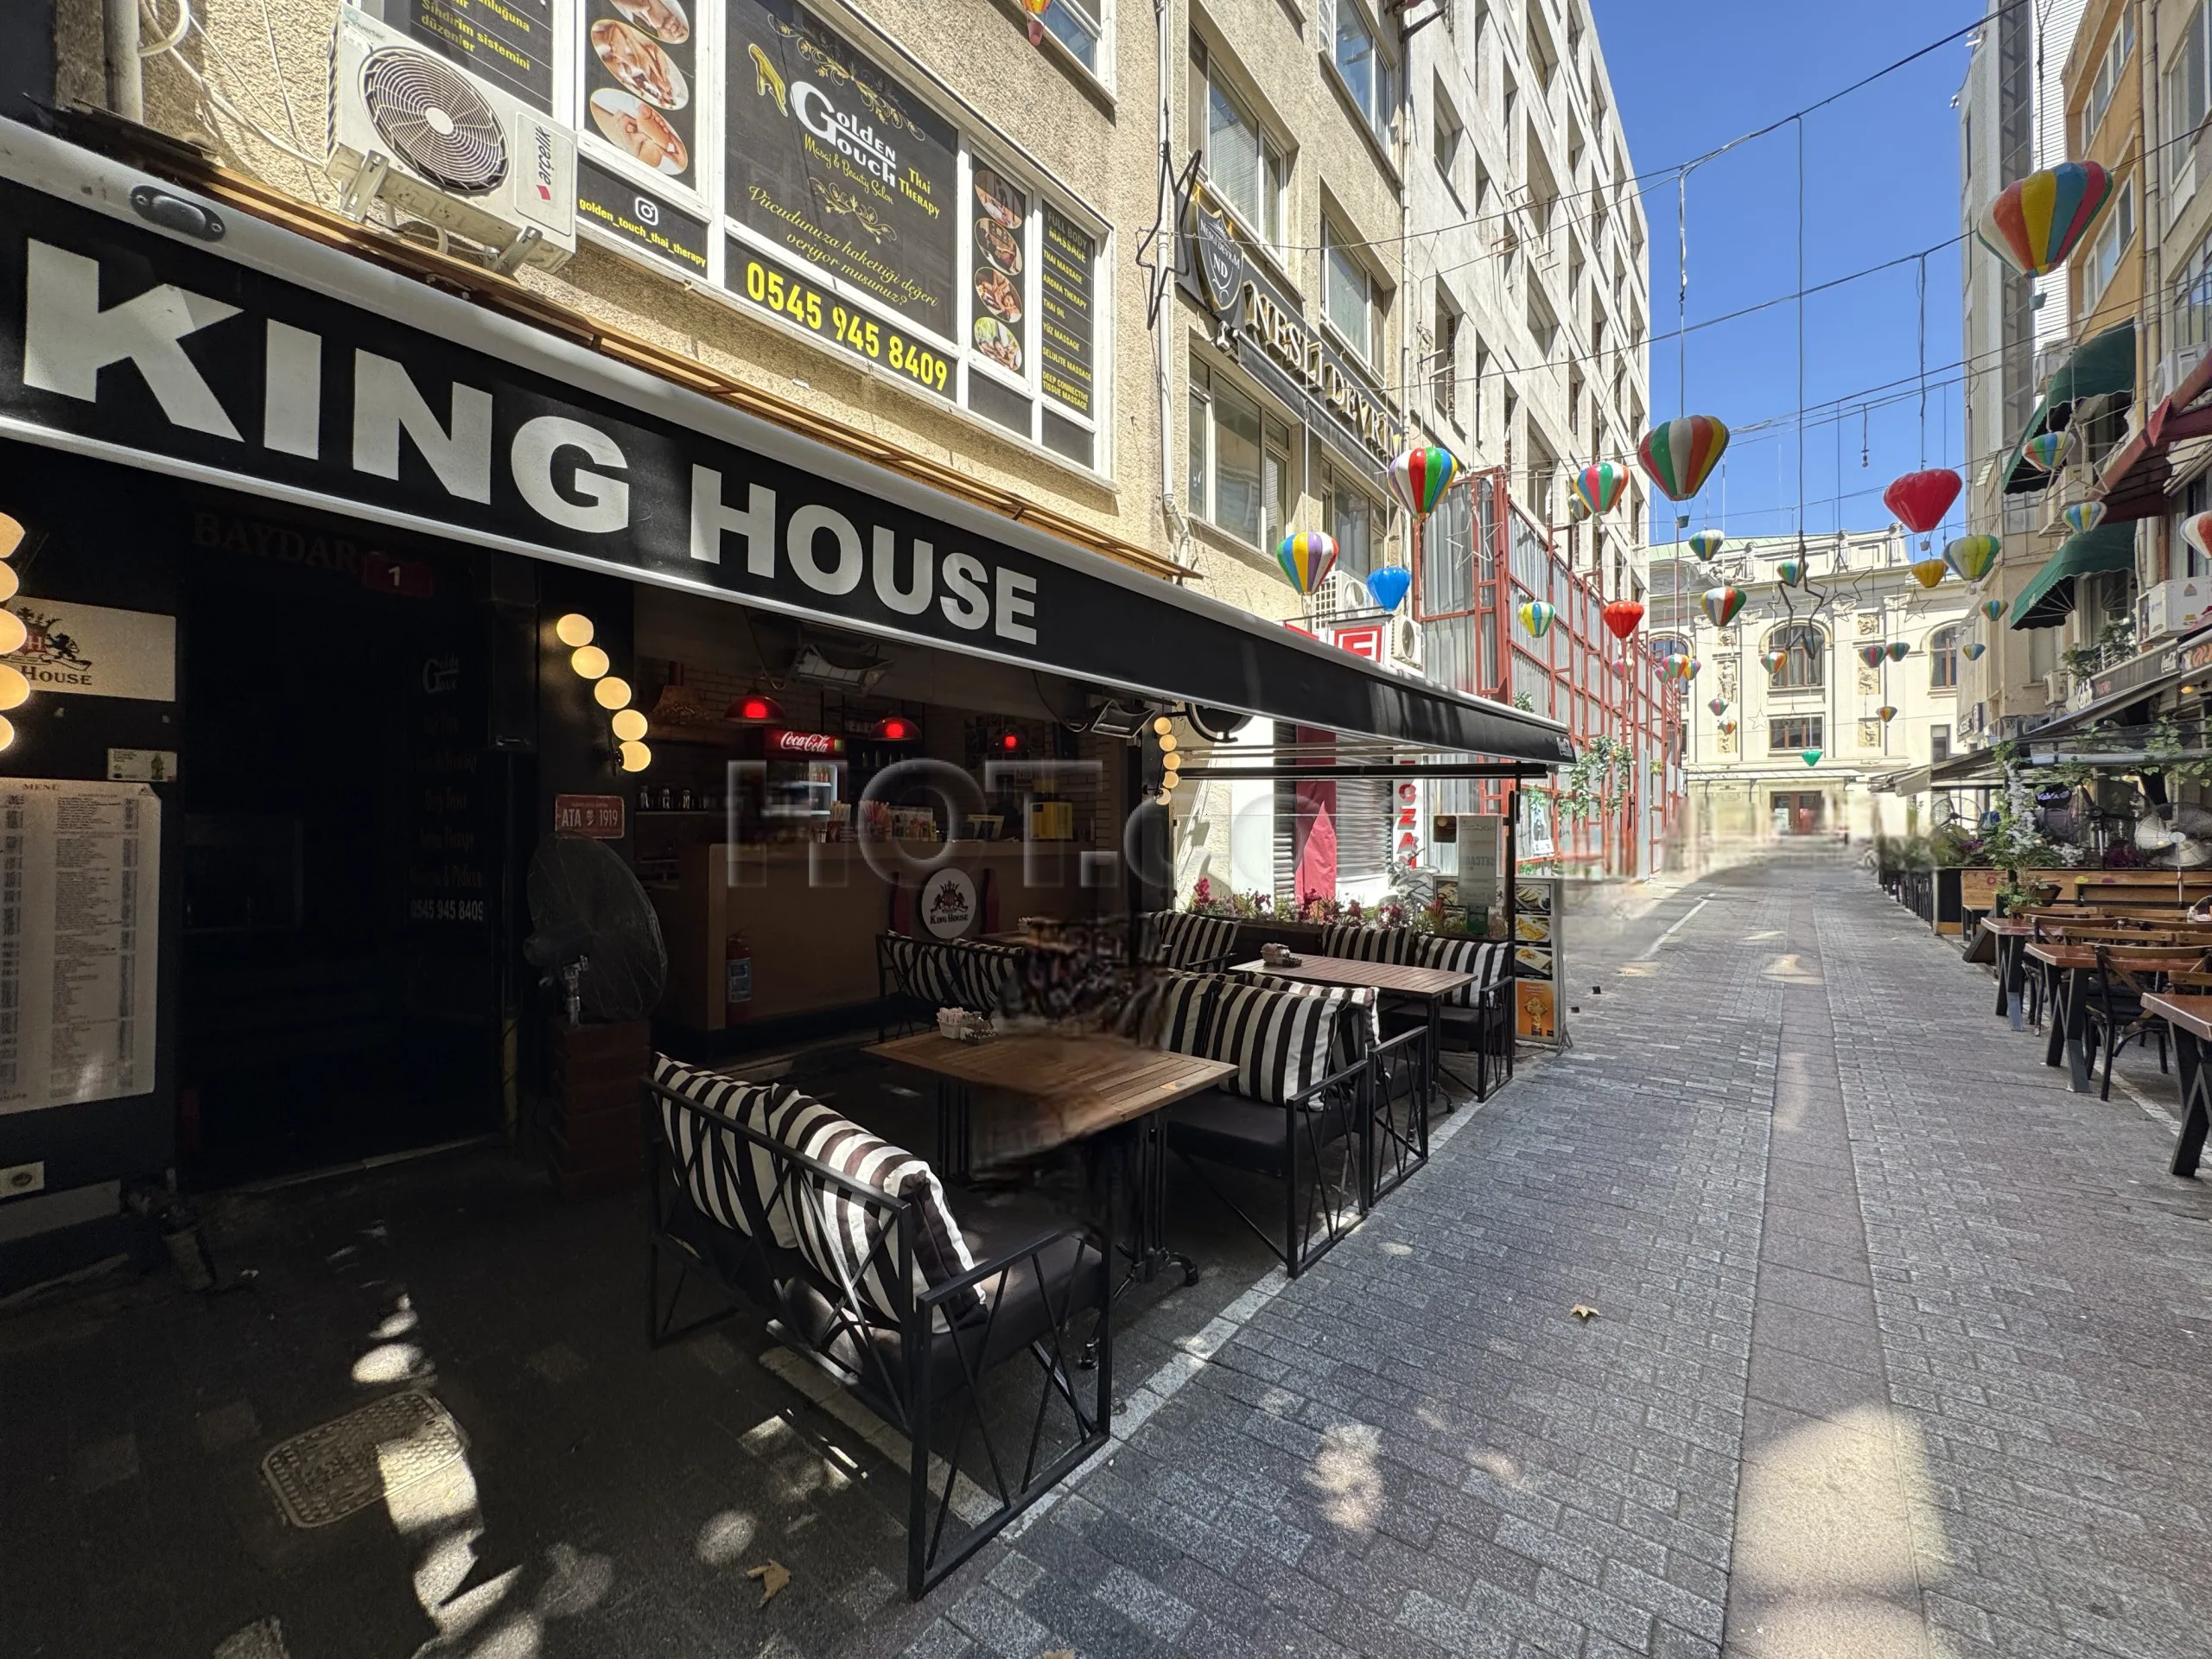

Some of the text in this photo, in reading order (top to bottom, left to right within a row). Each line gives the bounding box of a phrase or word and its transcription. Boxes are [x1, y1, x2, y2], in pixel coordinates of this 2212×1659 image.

[421, 14, 475, 52] düzenler
[477, 0, 530, 33] nluğuna
[476, 32, 531, 70] sistemini
[535, 126, 555, 186] arçelik
[804, 133, 894, 206] Masaj & Beauty Salon
[579, 199, 707, 268] golden_touch_thai_therapy
[748, 185, 938, 307] Vücudunuza hakettiği değeri
[1047, 210, 1088, 251] FULL BODY
[1048, 228, 1087, 264] MASSAGE
[786, 233, 908, 306] veriyor musunuz?
[1043, 249, 1082, 285] THAI MASSAGE
[1213, 252, 1229, 278] ND
[1043, 273, 1087, 310] AROMA THERAPY
[1043, 298, 1065, 320] THAI OIL
[747, 261, 948, 391] 0545 945 8409
[1043, 321, 1080, 353] YÜZ MASSAGE
[1042, 370, 1090, 403] DEEP CONNECTIVE
[1067, 360, 1092, 382] MASSAGE
[1042, 379, 1088, 411] TISSUE MASSAGE
[23, 238, 1037, 645] KING HOUSE
[388, 565, 402, 588] 1
[21, 664, 92, 685] HOUSE
[562, 808, 619, 827] ATA 1919
[436, 899, 456, 920] 945
[458, 899, 485, 922] 8409
